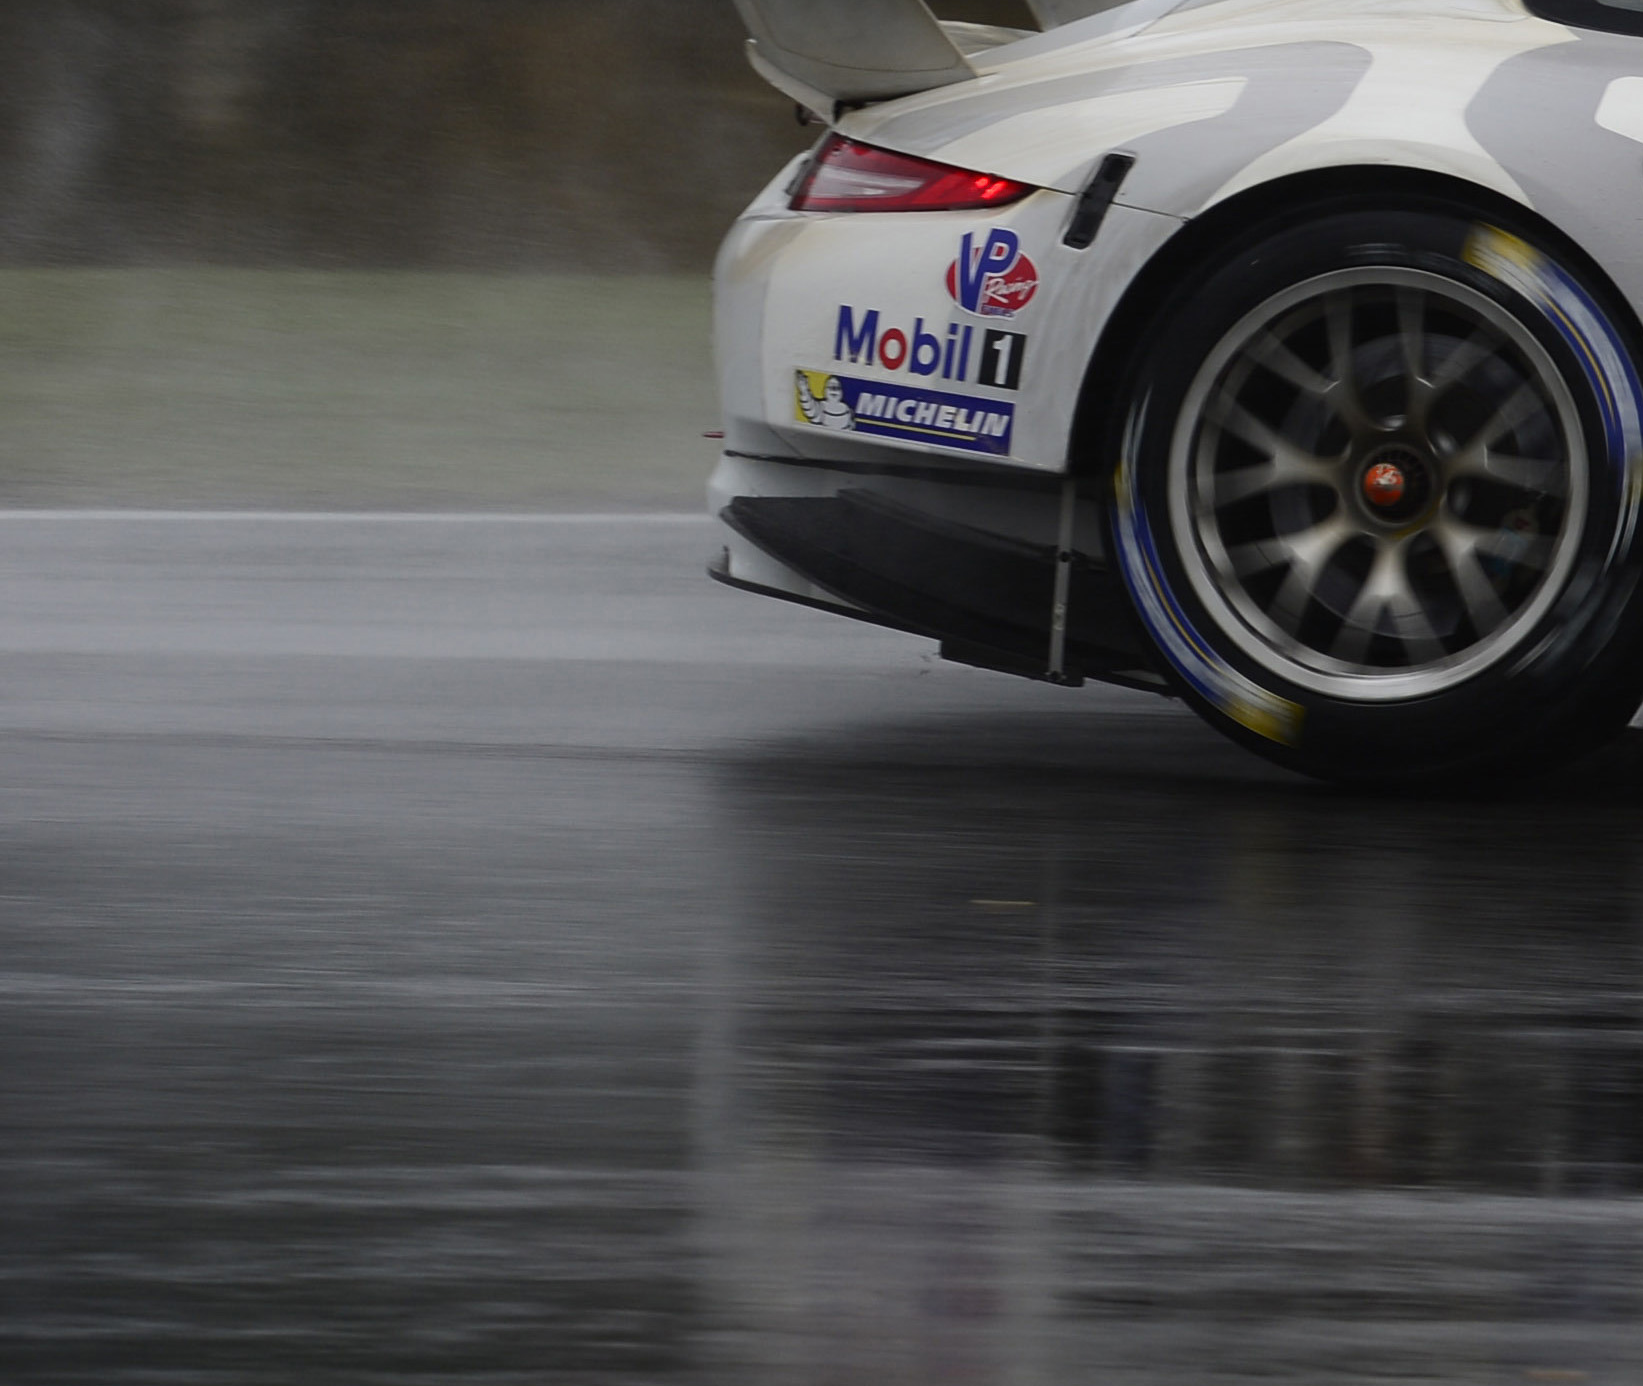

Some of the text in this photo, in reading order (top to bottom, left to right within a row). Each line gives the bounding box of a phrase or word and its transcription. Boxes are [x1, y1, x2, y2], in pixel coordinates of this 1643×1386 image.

[959, 227, 1019, 314] VP
[834, 304, 974, 382] Mobil
[855, 392, 1010, 437] MICHELIN
